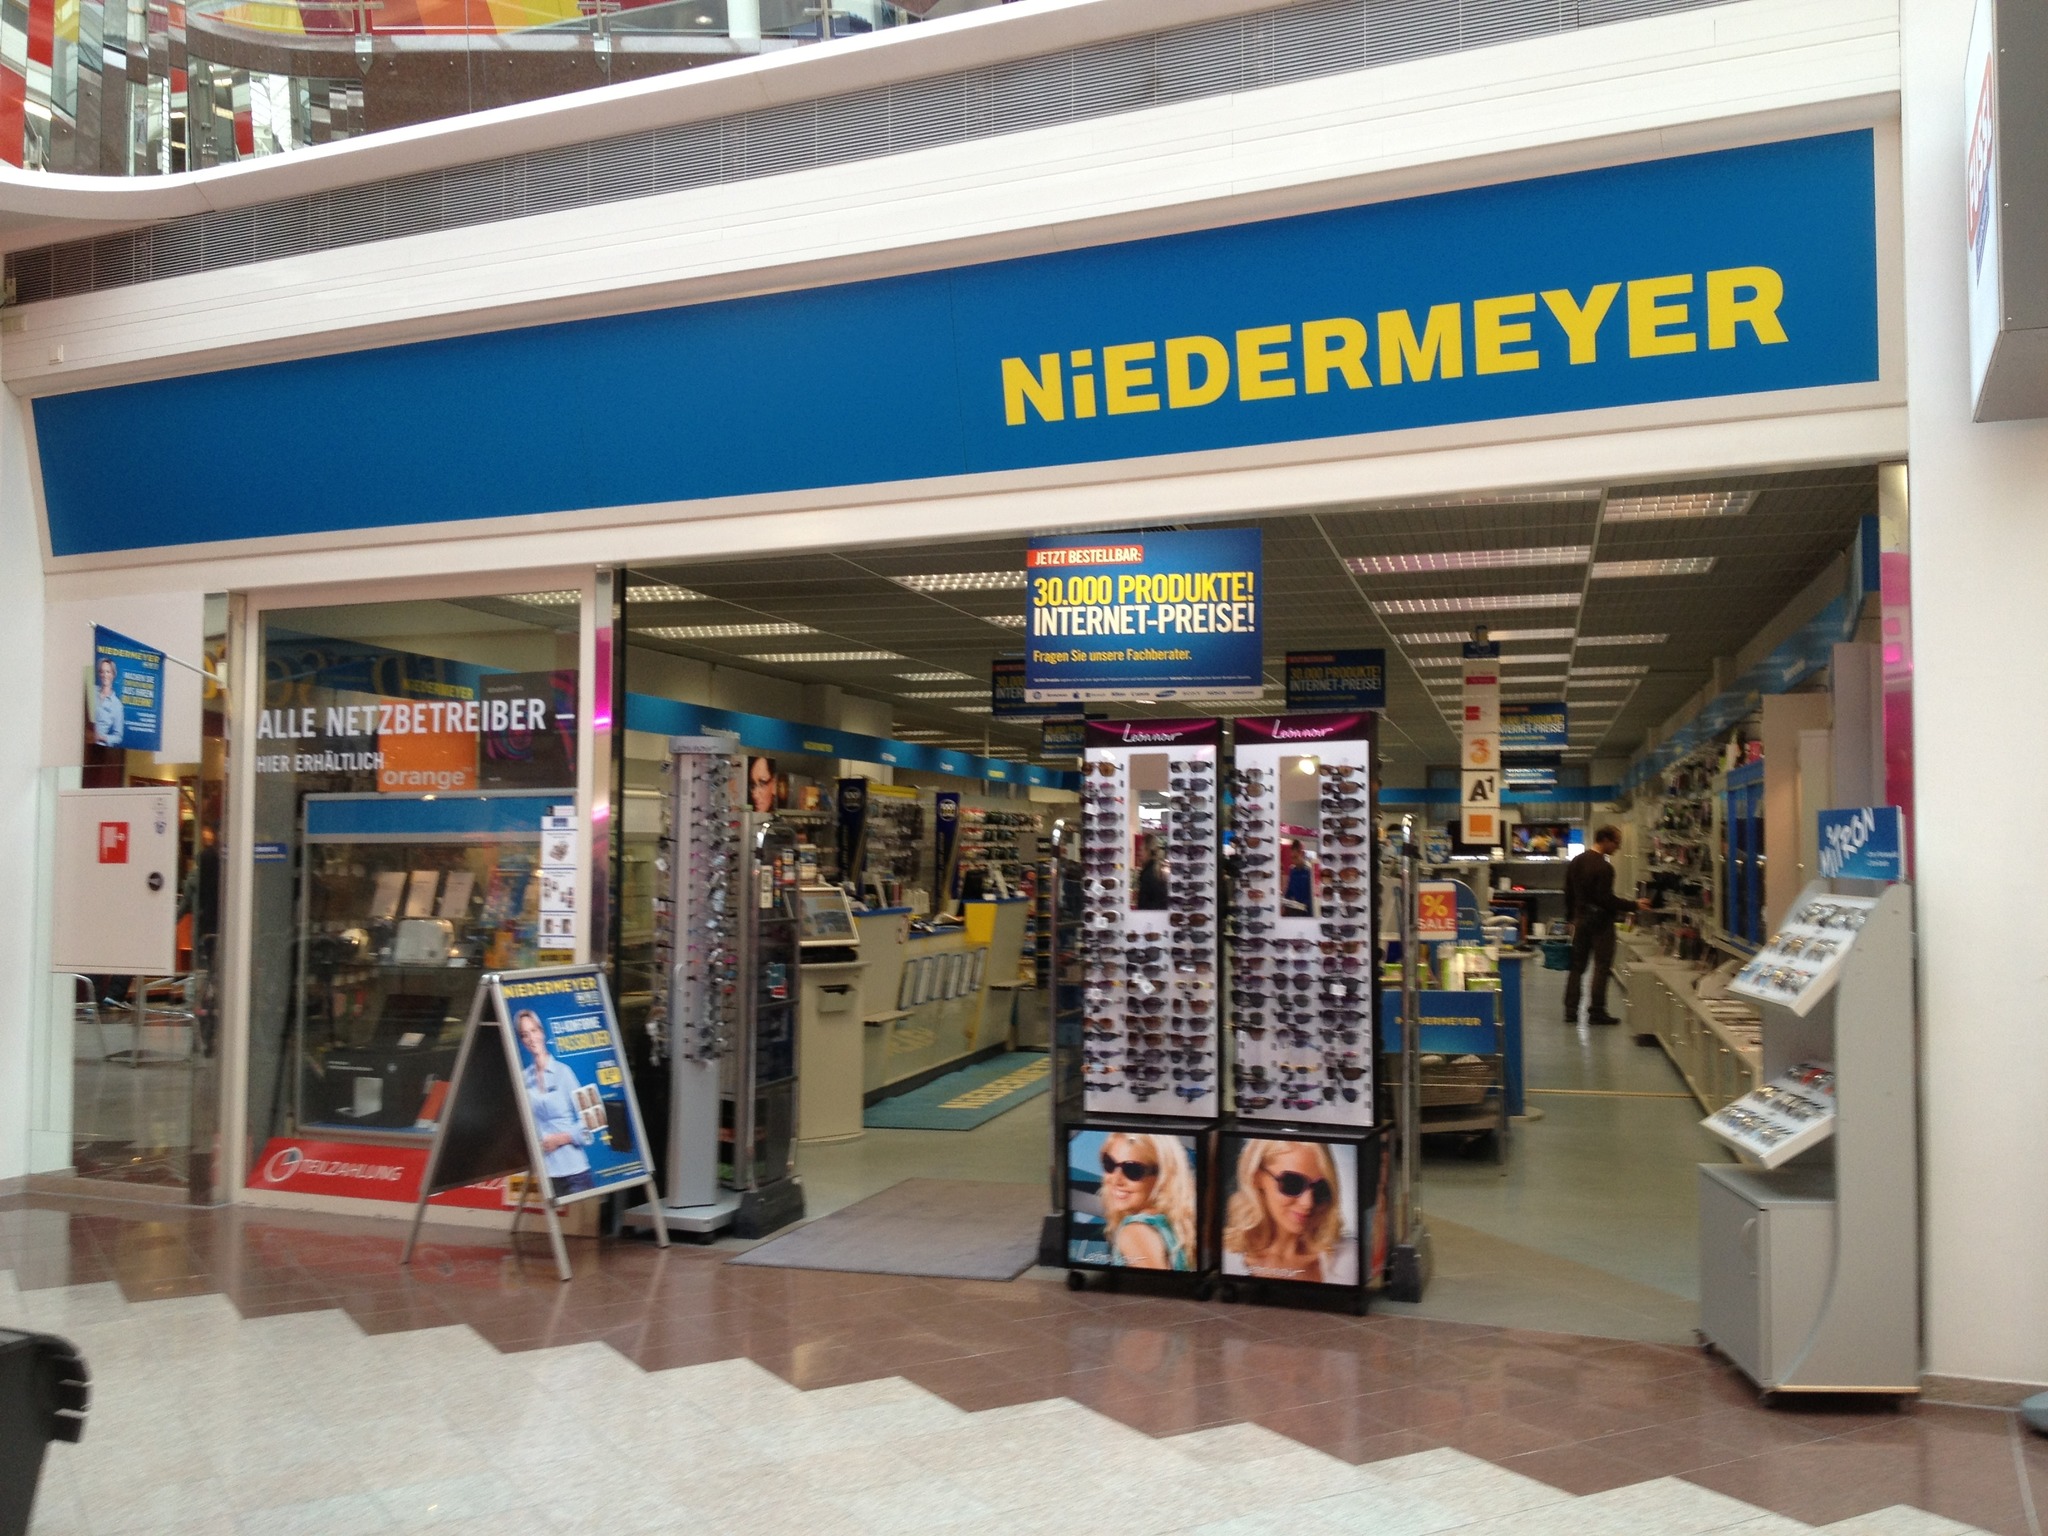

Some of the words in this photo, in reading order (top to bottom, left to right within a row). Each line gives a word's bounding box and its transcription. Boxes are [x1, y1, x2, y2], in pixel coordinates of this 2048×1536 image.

[1034, 550, 1067, 566] JETZT
[1068, 547, 1142, 564] BESTELLBAR:
[1033, 575, 1113, 607] 30.000
[1118, 571, 1255, 604] PRODUKTE!
[1033, 602, 1256, 637] INTERNET-PREISE!
[1033, 649, 1069, 665] Fragen
[1071, 648, 1087, 662] Sie
[1089, 651, 1125, 662] unsere
[257, 706, 317, 739] ALLE
[325, 698, 547, 738] NETZBETREIBER
[256, 754, 290, 773] HIER
[294, 750, 385, 773] ERHÄLTLICH
[383, 770, 466, 790] orange
[1417, 917, 1456, 931] SALE
[503, 976, 598, 999] NIEDERMEYER
